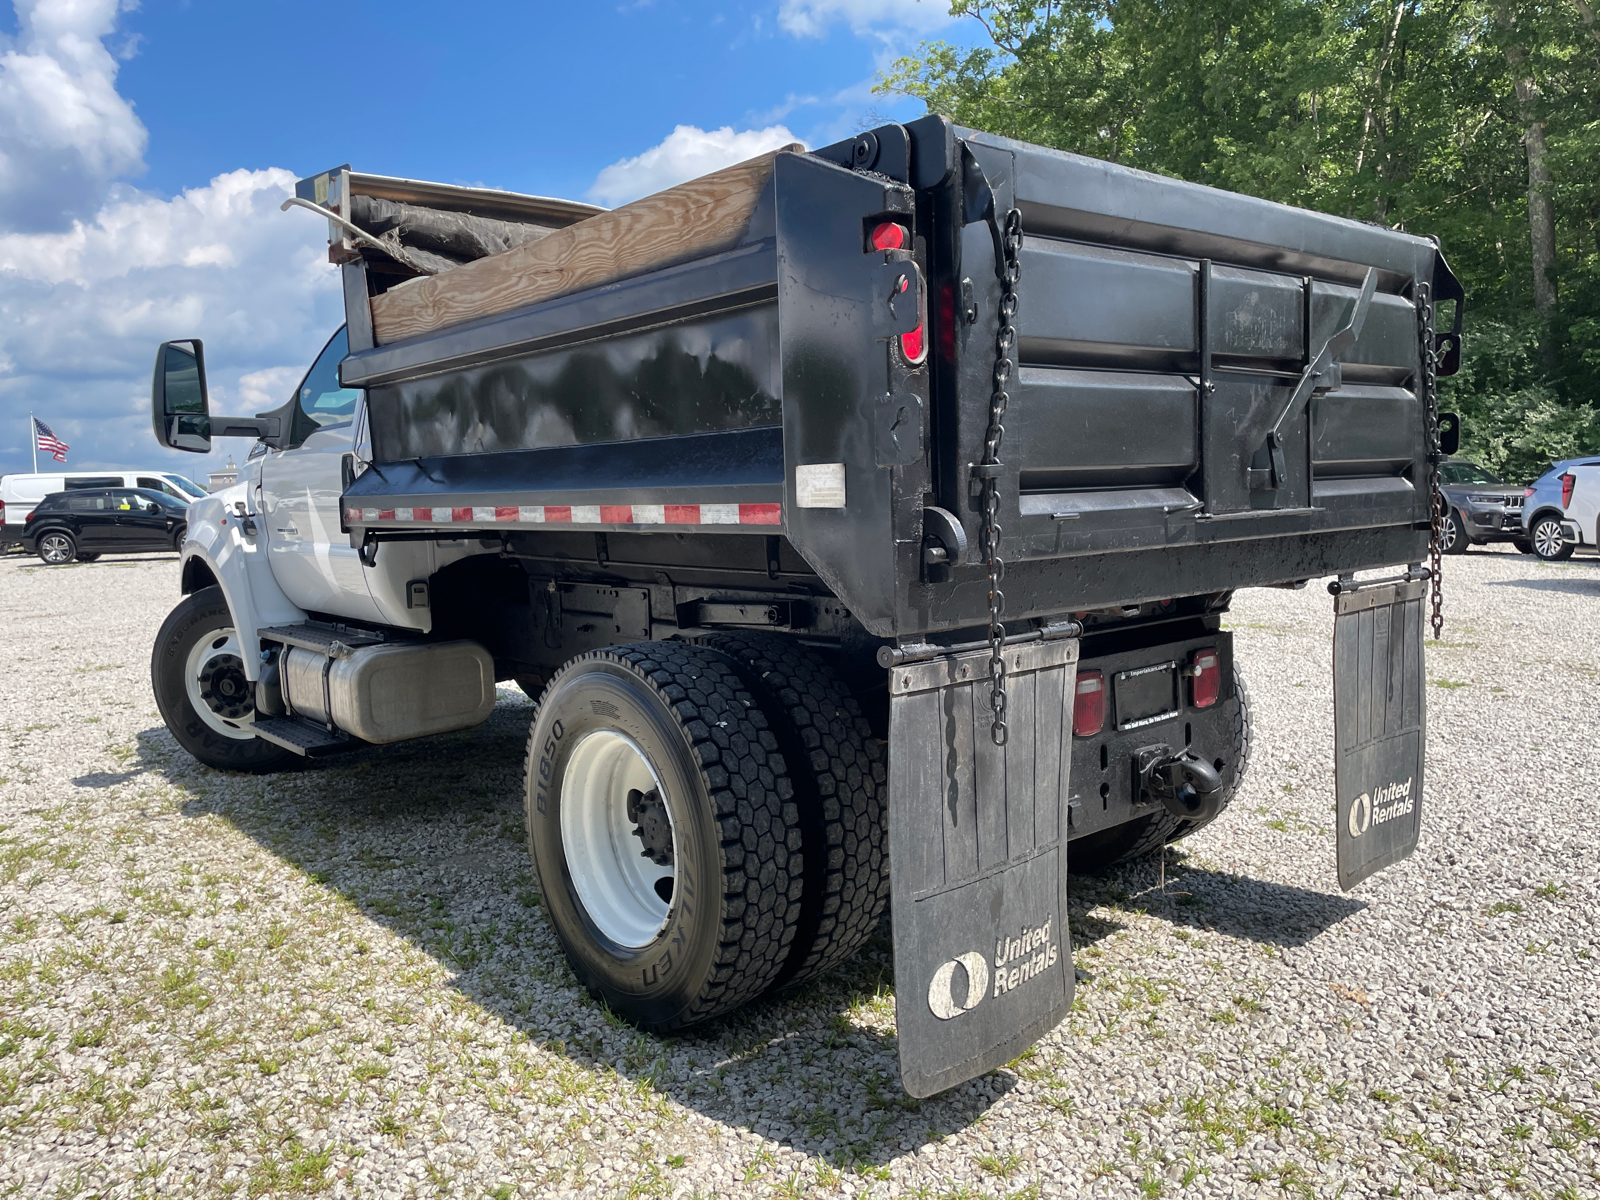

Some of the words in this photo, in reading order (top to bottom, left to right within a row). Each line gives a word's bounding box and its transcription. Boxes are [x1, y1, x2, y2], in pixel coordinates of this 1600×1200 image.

[1371, 796, 1414, 827] Rentals
[1373, 776, 1412, 806] United
[994, 914, 1052, 968] United
[992, 942, 1058, 999] Rentals
